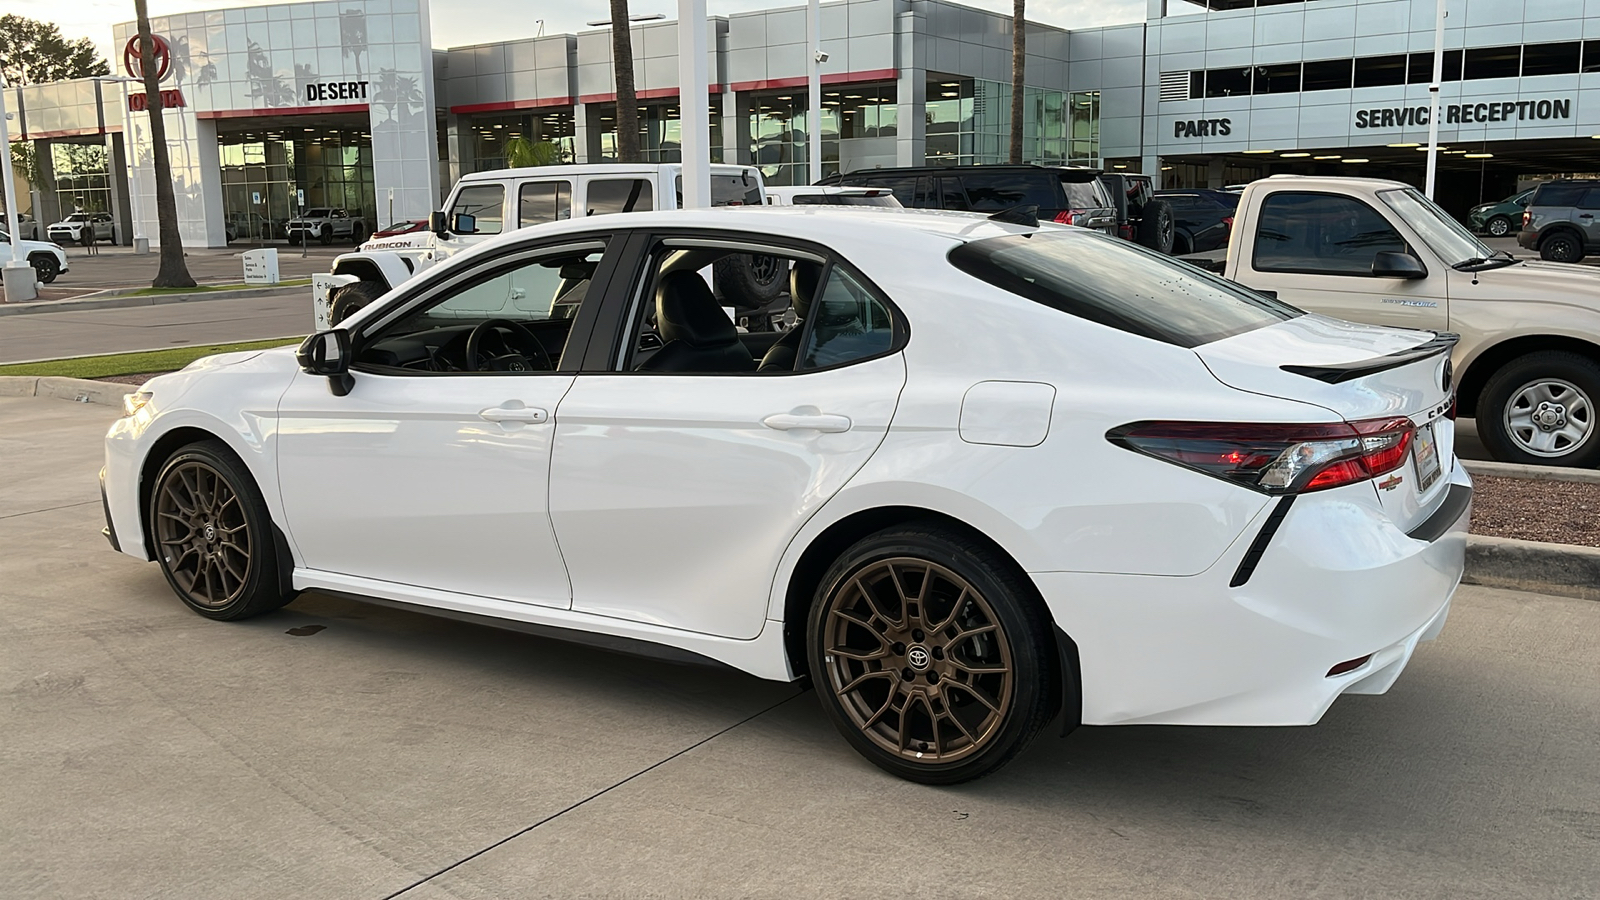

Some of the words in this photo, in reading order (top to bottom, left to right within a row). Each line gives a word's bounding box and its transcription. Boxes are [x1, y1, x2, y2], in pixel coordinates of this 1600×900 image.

[127, 89, 185, 111] TOYTA
[306, 81, 369, 101] DESERT
[1446, 99, 1570, 124] RECEPTION
[1174, 118, 1231, 138] PARTS
[364, 241, 412, 251] RUBICON
